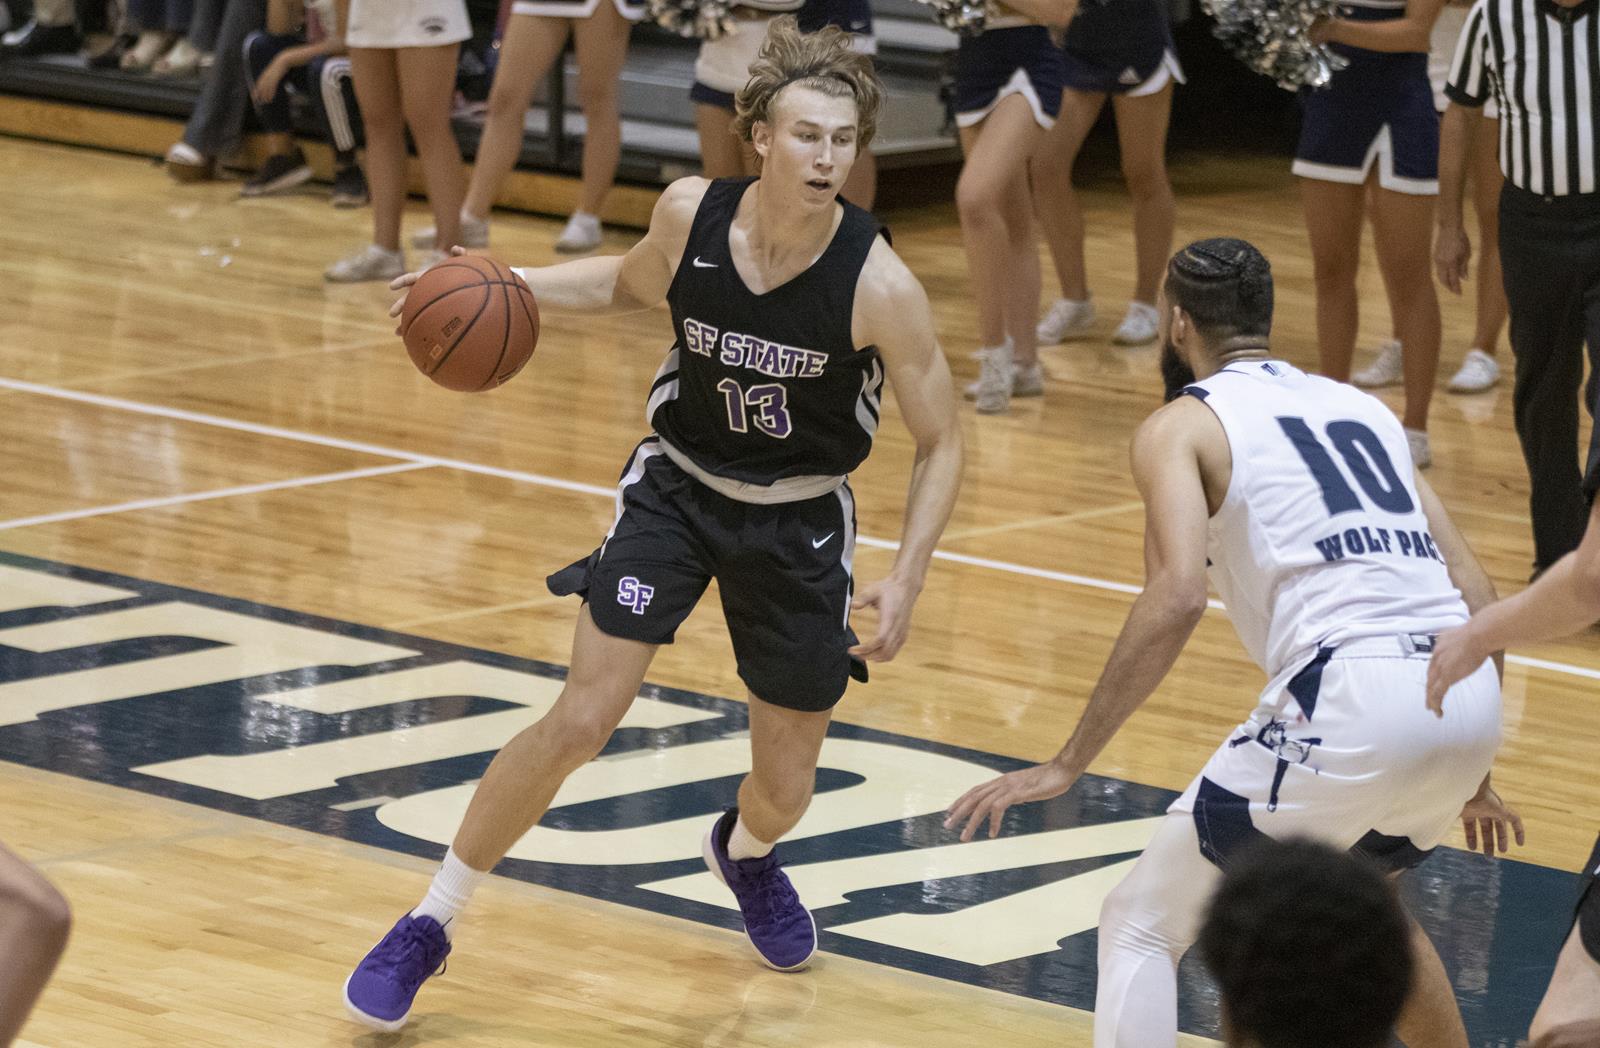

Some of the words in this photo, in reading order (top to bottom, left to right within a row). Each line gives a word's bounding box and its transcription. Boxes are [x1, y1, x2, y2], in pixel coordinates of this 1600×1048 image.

[683, 317, 719, 358] SF
[720, 332, 829, 378] STATE
[717, 377, 792, 440] 13
[1274, 416, 1416, 518] 10
[1315, 526, 1392, 562] WOLF
[1394, 529, 1440, 562] PAC
[617, 576, 655, 615] SF
